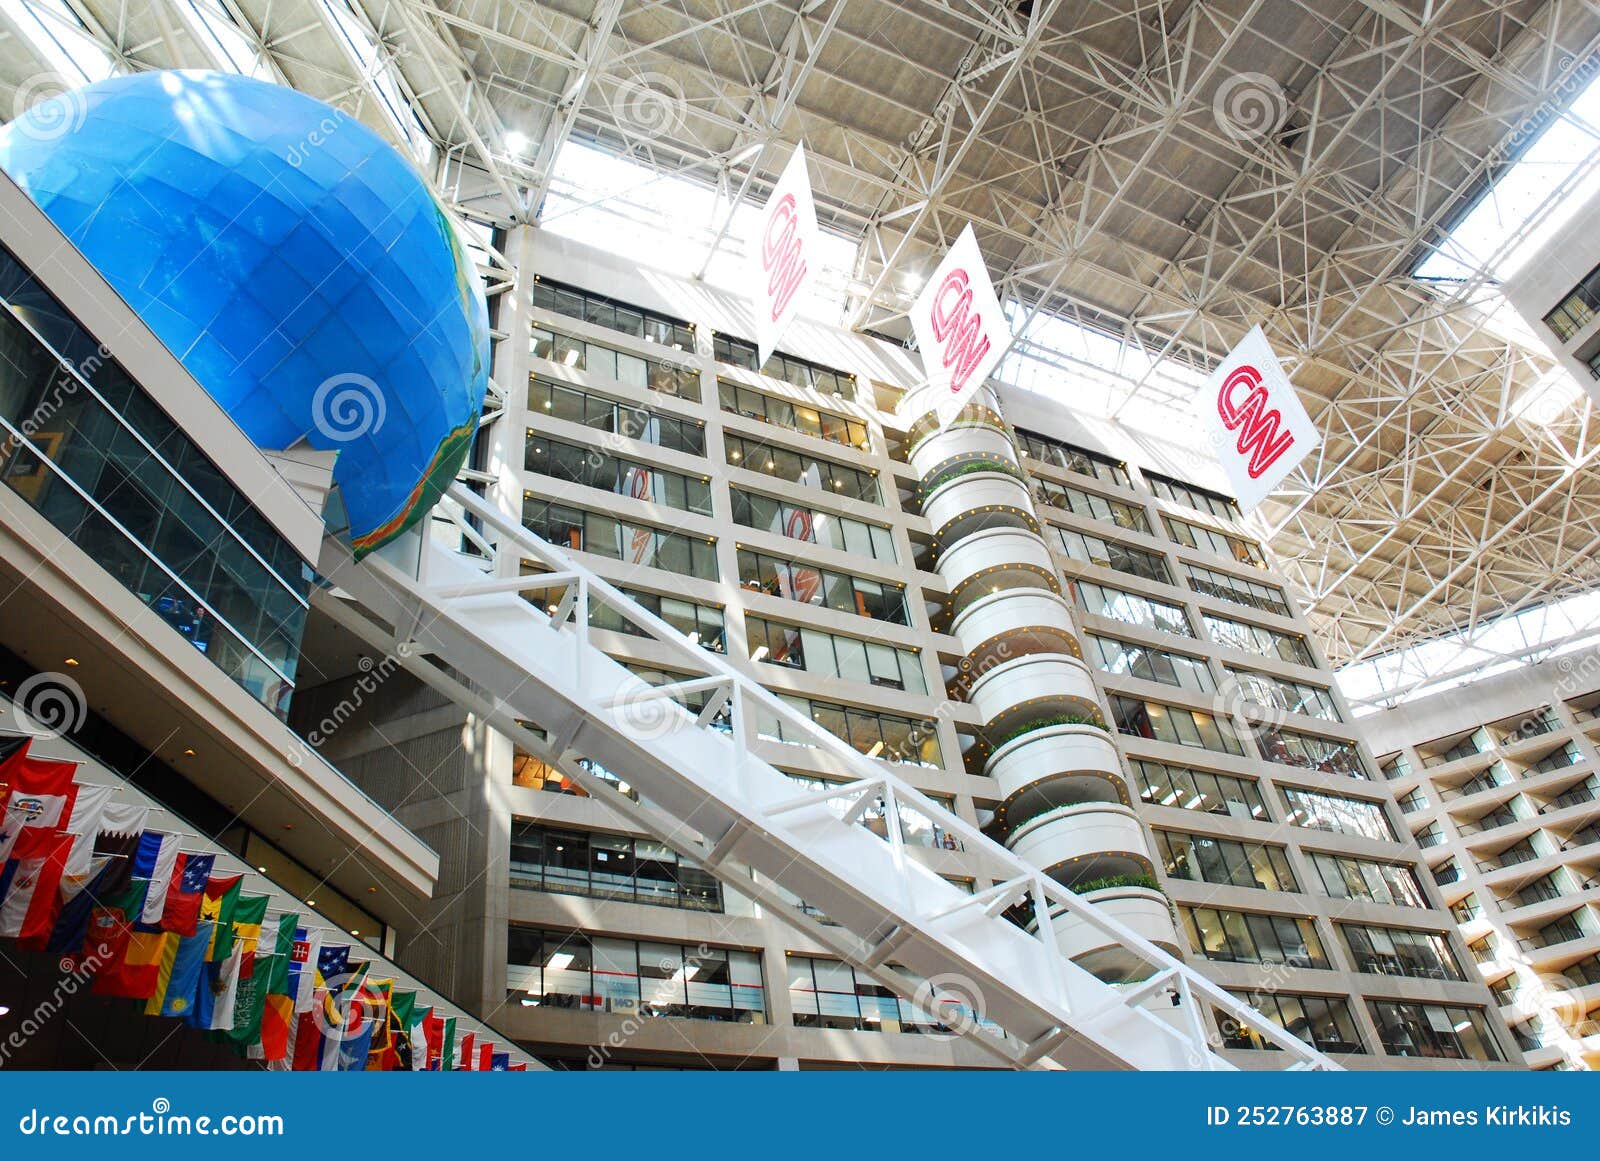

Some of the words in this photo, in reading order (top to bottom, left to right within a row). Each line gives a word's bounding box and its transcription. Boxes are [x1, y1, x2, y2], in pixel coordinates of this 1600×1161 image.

[762, 192, 807, 323] CNN
[930, 268, 991, 394] CNN
[1217, 365, 1295, 479] CNN
